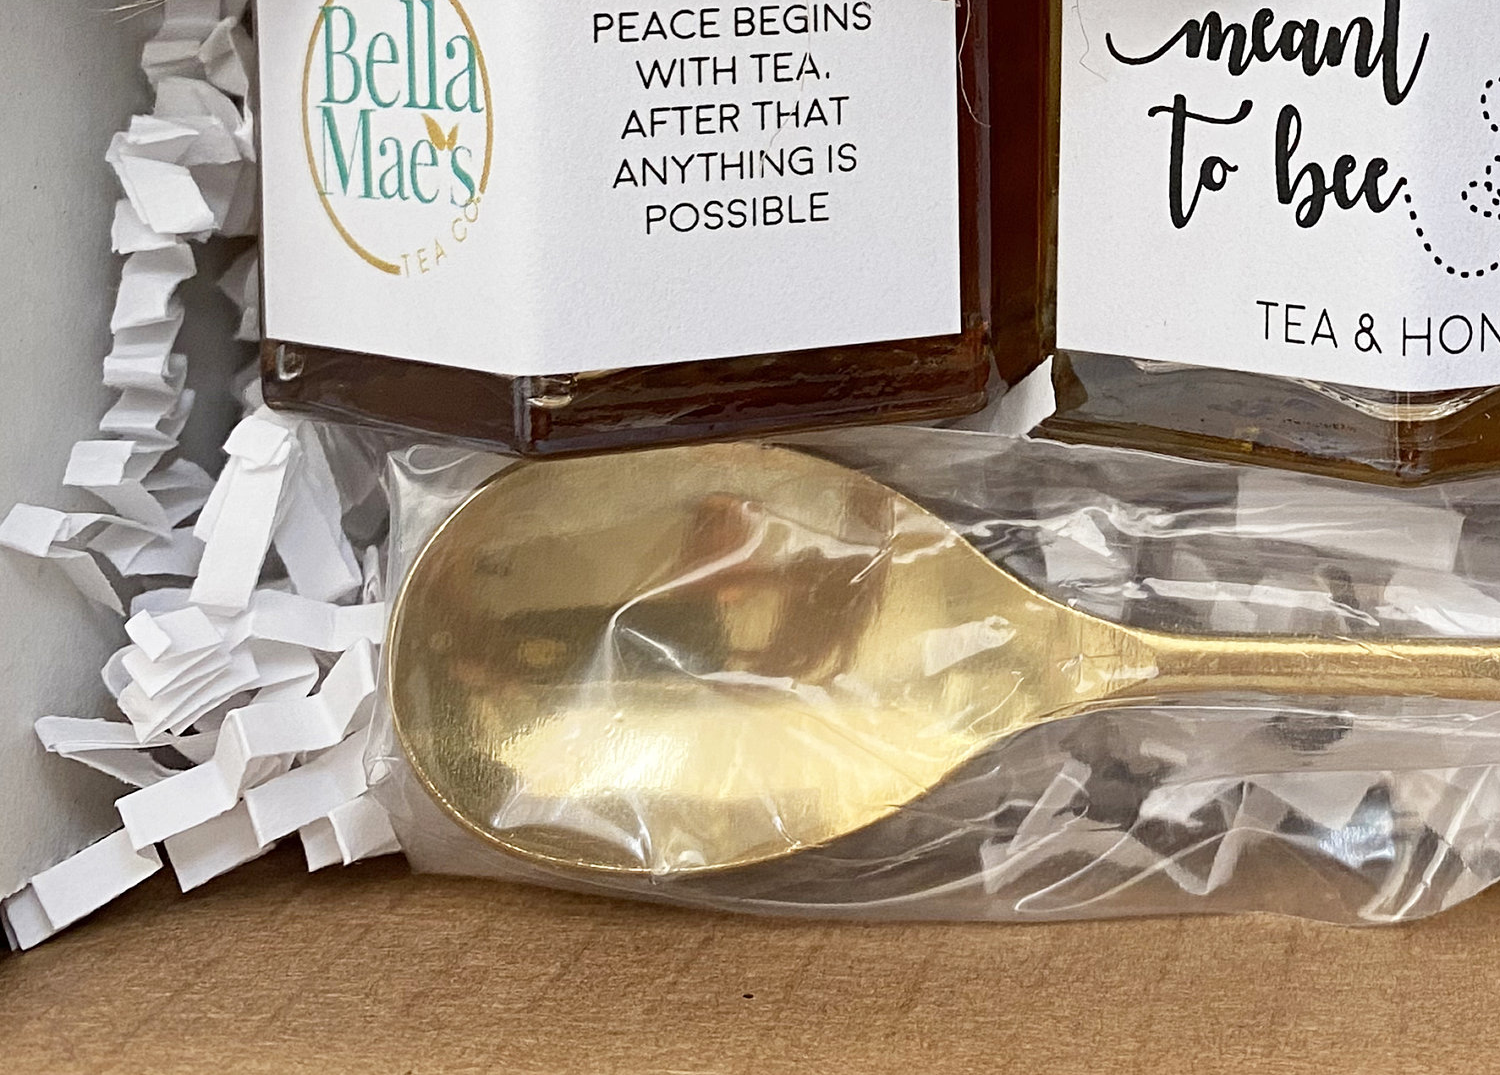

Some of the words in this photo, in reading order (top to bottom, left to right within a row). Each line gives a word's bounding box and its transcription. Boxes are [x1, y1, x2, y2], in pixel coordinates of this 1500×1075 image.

[593, 7, 721, 44] PEACE
[734, 1, 872, 37] BEGINS
[635, 55, 737, 90] WITH
[749, 51, 830, 84] TEA.
[620, 103, 740, 140] AFTER
[751, 95, 850, 131] THAT
[612, 145, 814, 189] ANYTHING
[828, 142, 857, 174] IS
[1147, 93, 1254, 230] to
[1274, 103, 1408, 229] bee
[646, 191, 830, 235] POSSIBLE
[400, 238, 448, 278] TEA
[1256, 300, 1338, 349] TEA
[1354, 312, 1383, 354] &
